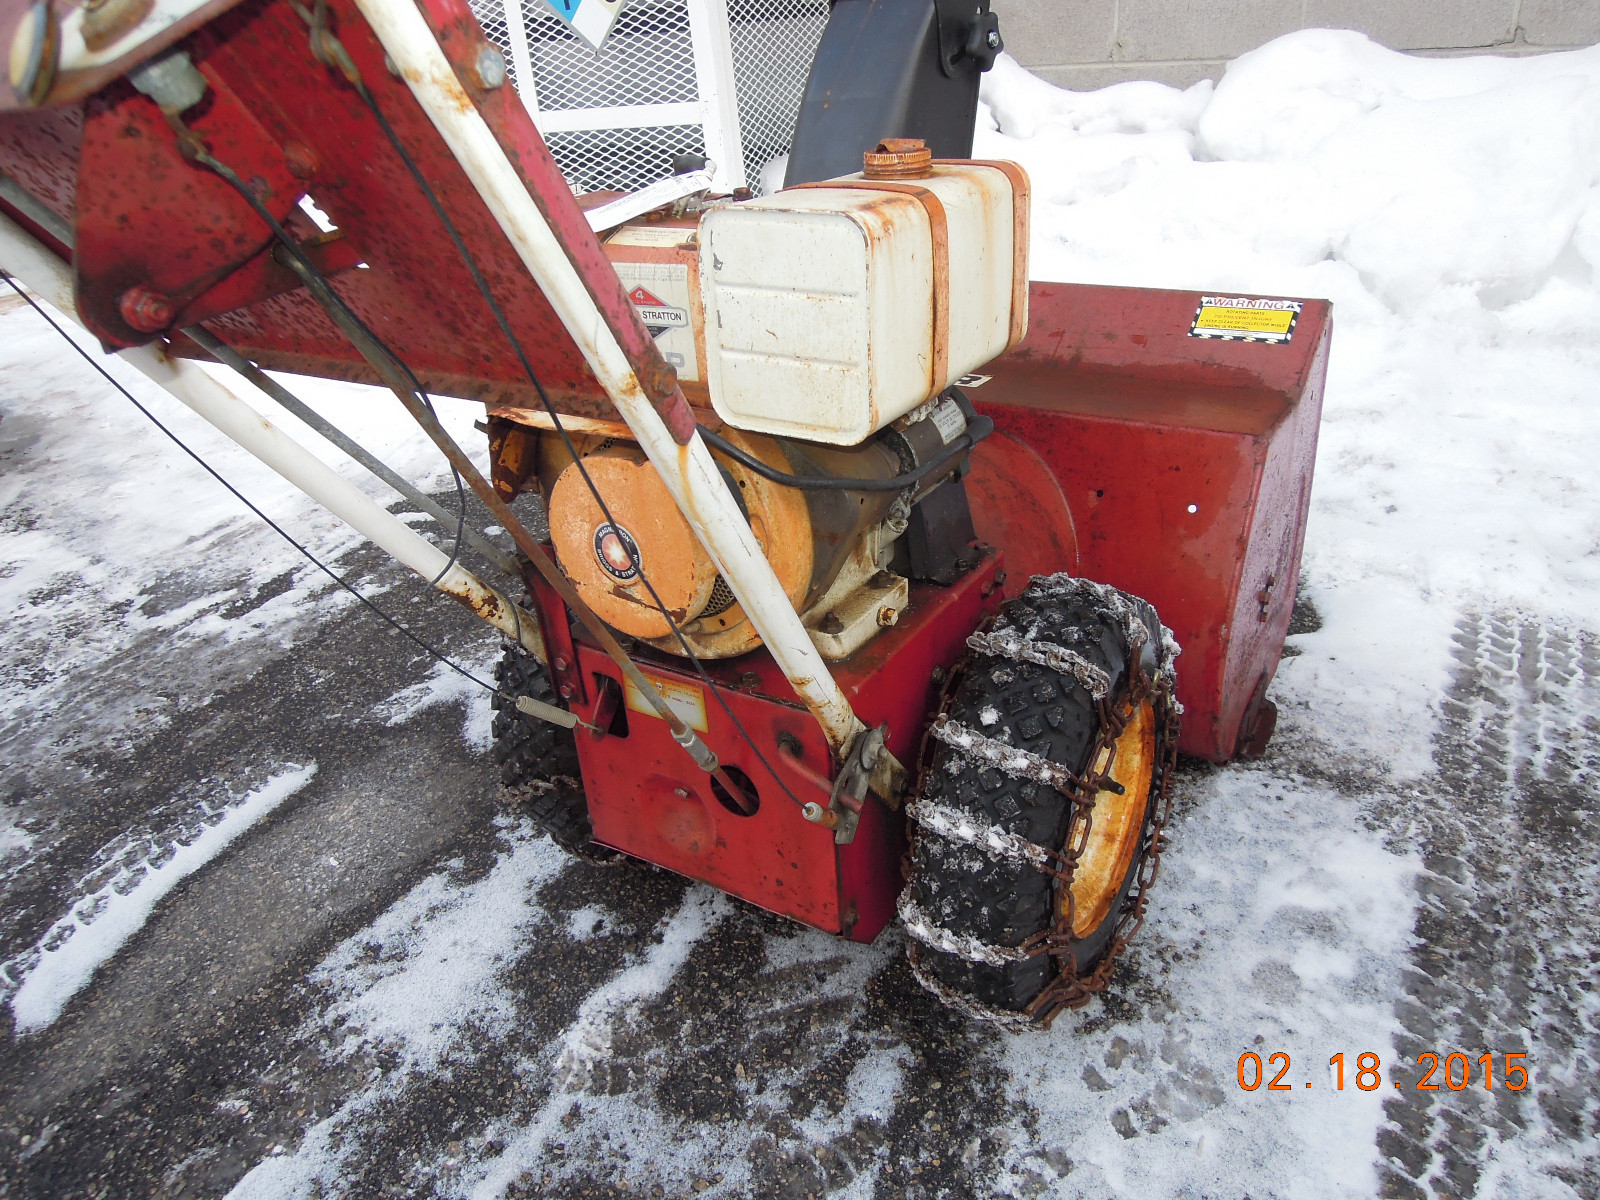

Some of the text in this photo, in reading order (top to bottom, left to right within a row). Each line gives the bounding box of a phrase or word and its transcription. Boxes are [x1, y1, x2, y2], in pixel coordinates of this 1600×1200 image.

[635, 290, 645, 299] 4
[1213, 298, 1285, 309] WARNING
[642, 310, 682, 321] STRATTON
